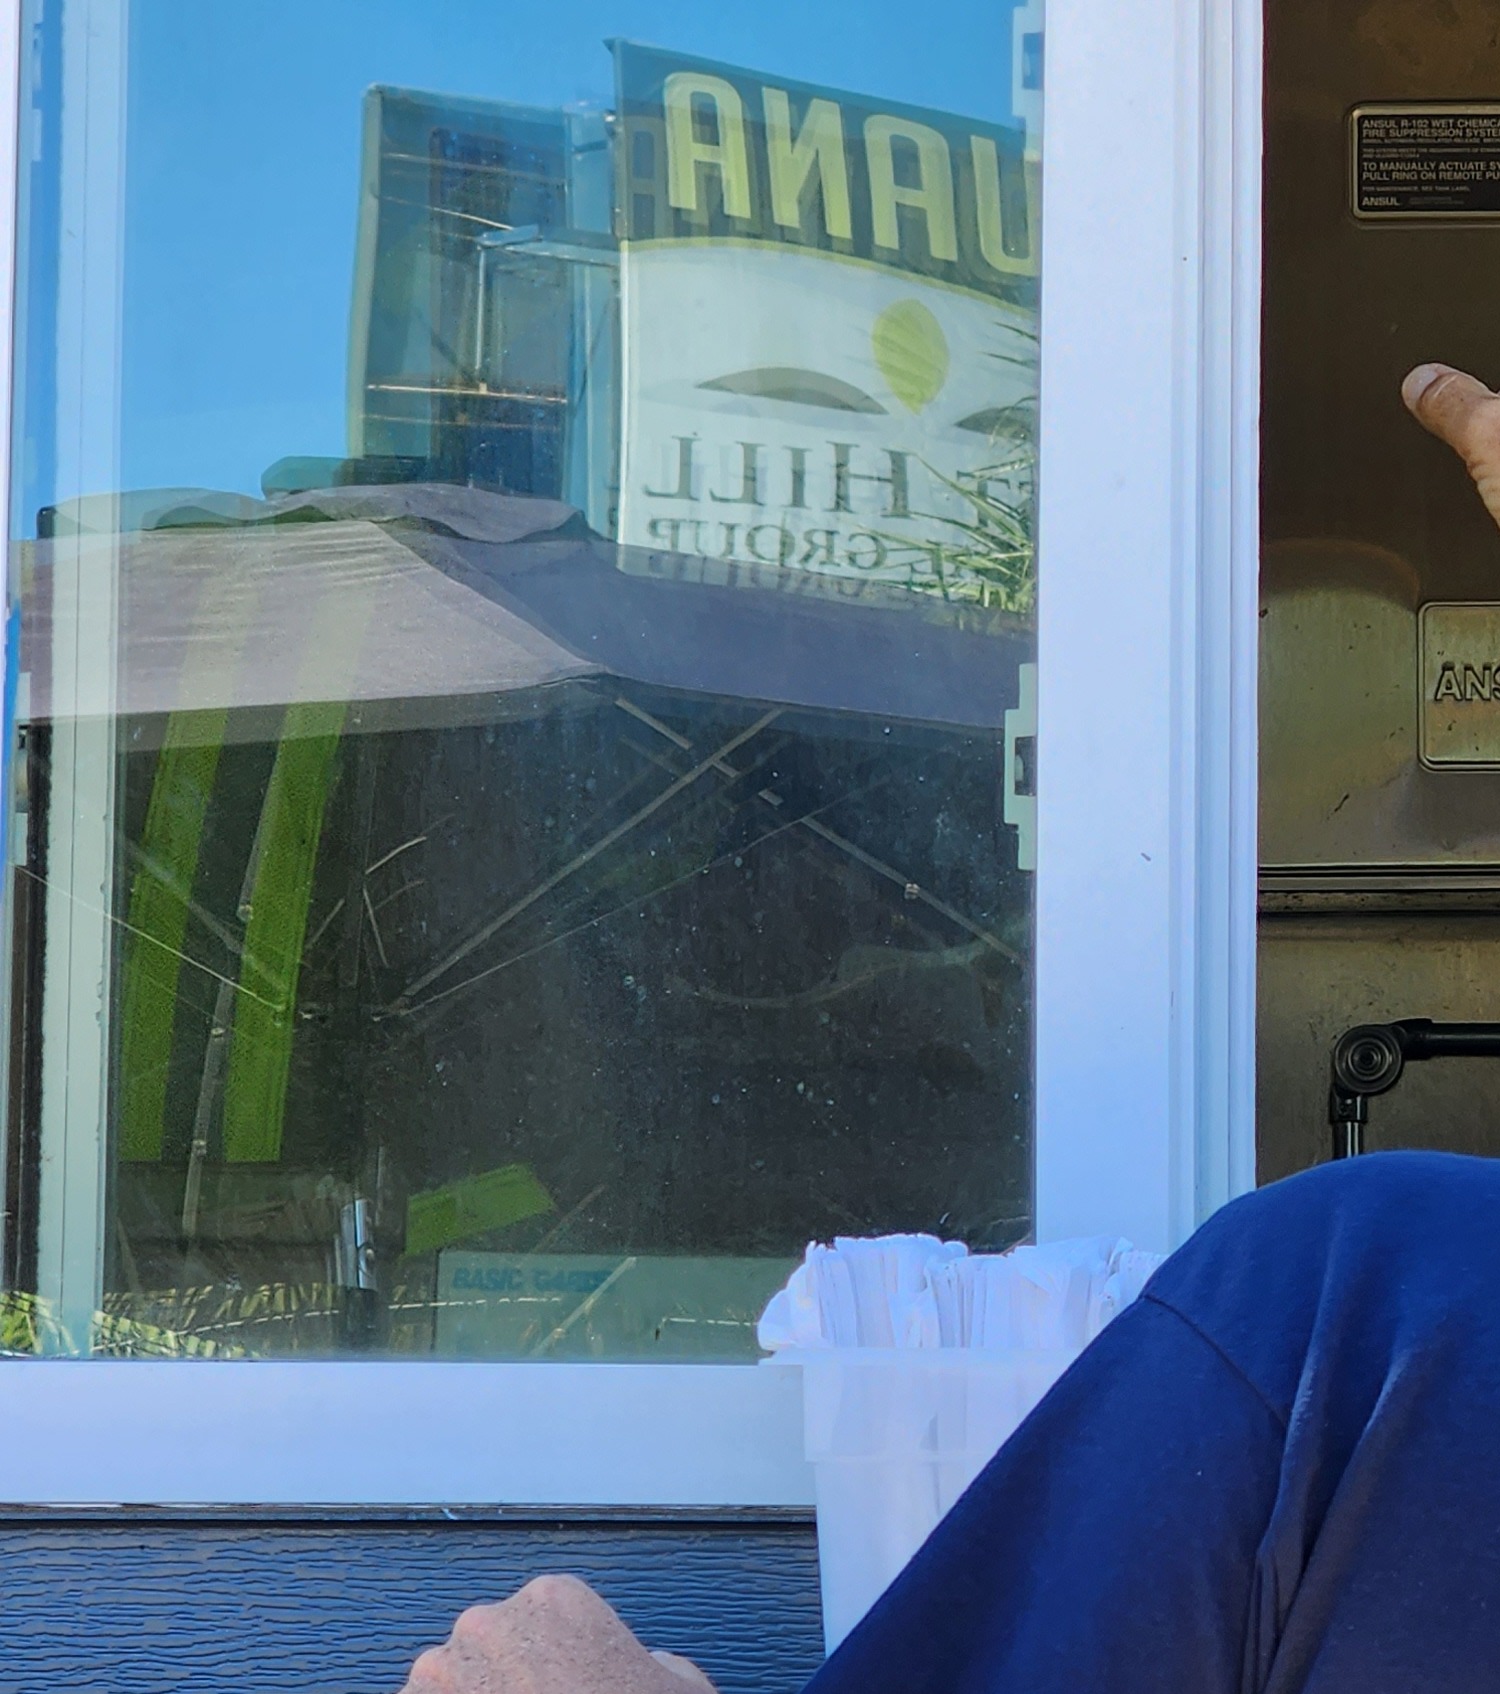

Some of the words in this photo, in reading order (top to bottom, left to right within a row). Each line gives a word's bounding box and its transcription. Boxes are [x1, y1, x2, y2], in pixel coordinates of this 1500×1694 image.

[1362, 119, 1398, 129] ANSUL
[1401, 119, 1429, 129] R-102
[1431, 118, 1454, 128] WET
[1362, 128, 1386, 138] FIRE
[1389, 128, 1463, 138] SUPPRESSION
[1362, 162, 1377, 171] TO
[1380, 162, 1437, 171] MANUALLY
[1439, 161, 1486, 171] ACTUATE
[1362, 171, 1390, 181] PULL
[1392, 171, 1418, 180] RING
[1420, 171, 1437, 180] ON
[1439, 171, 1483, 180] REMOTE
[1362, 196, 1401, 206] ANSUL
